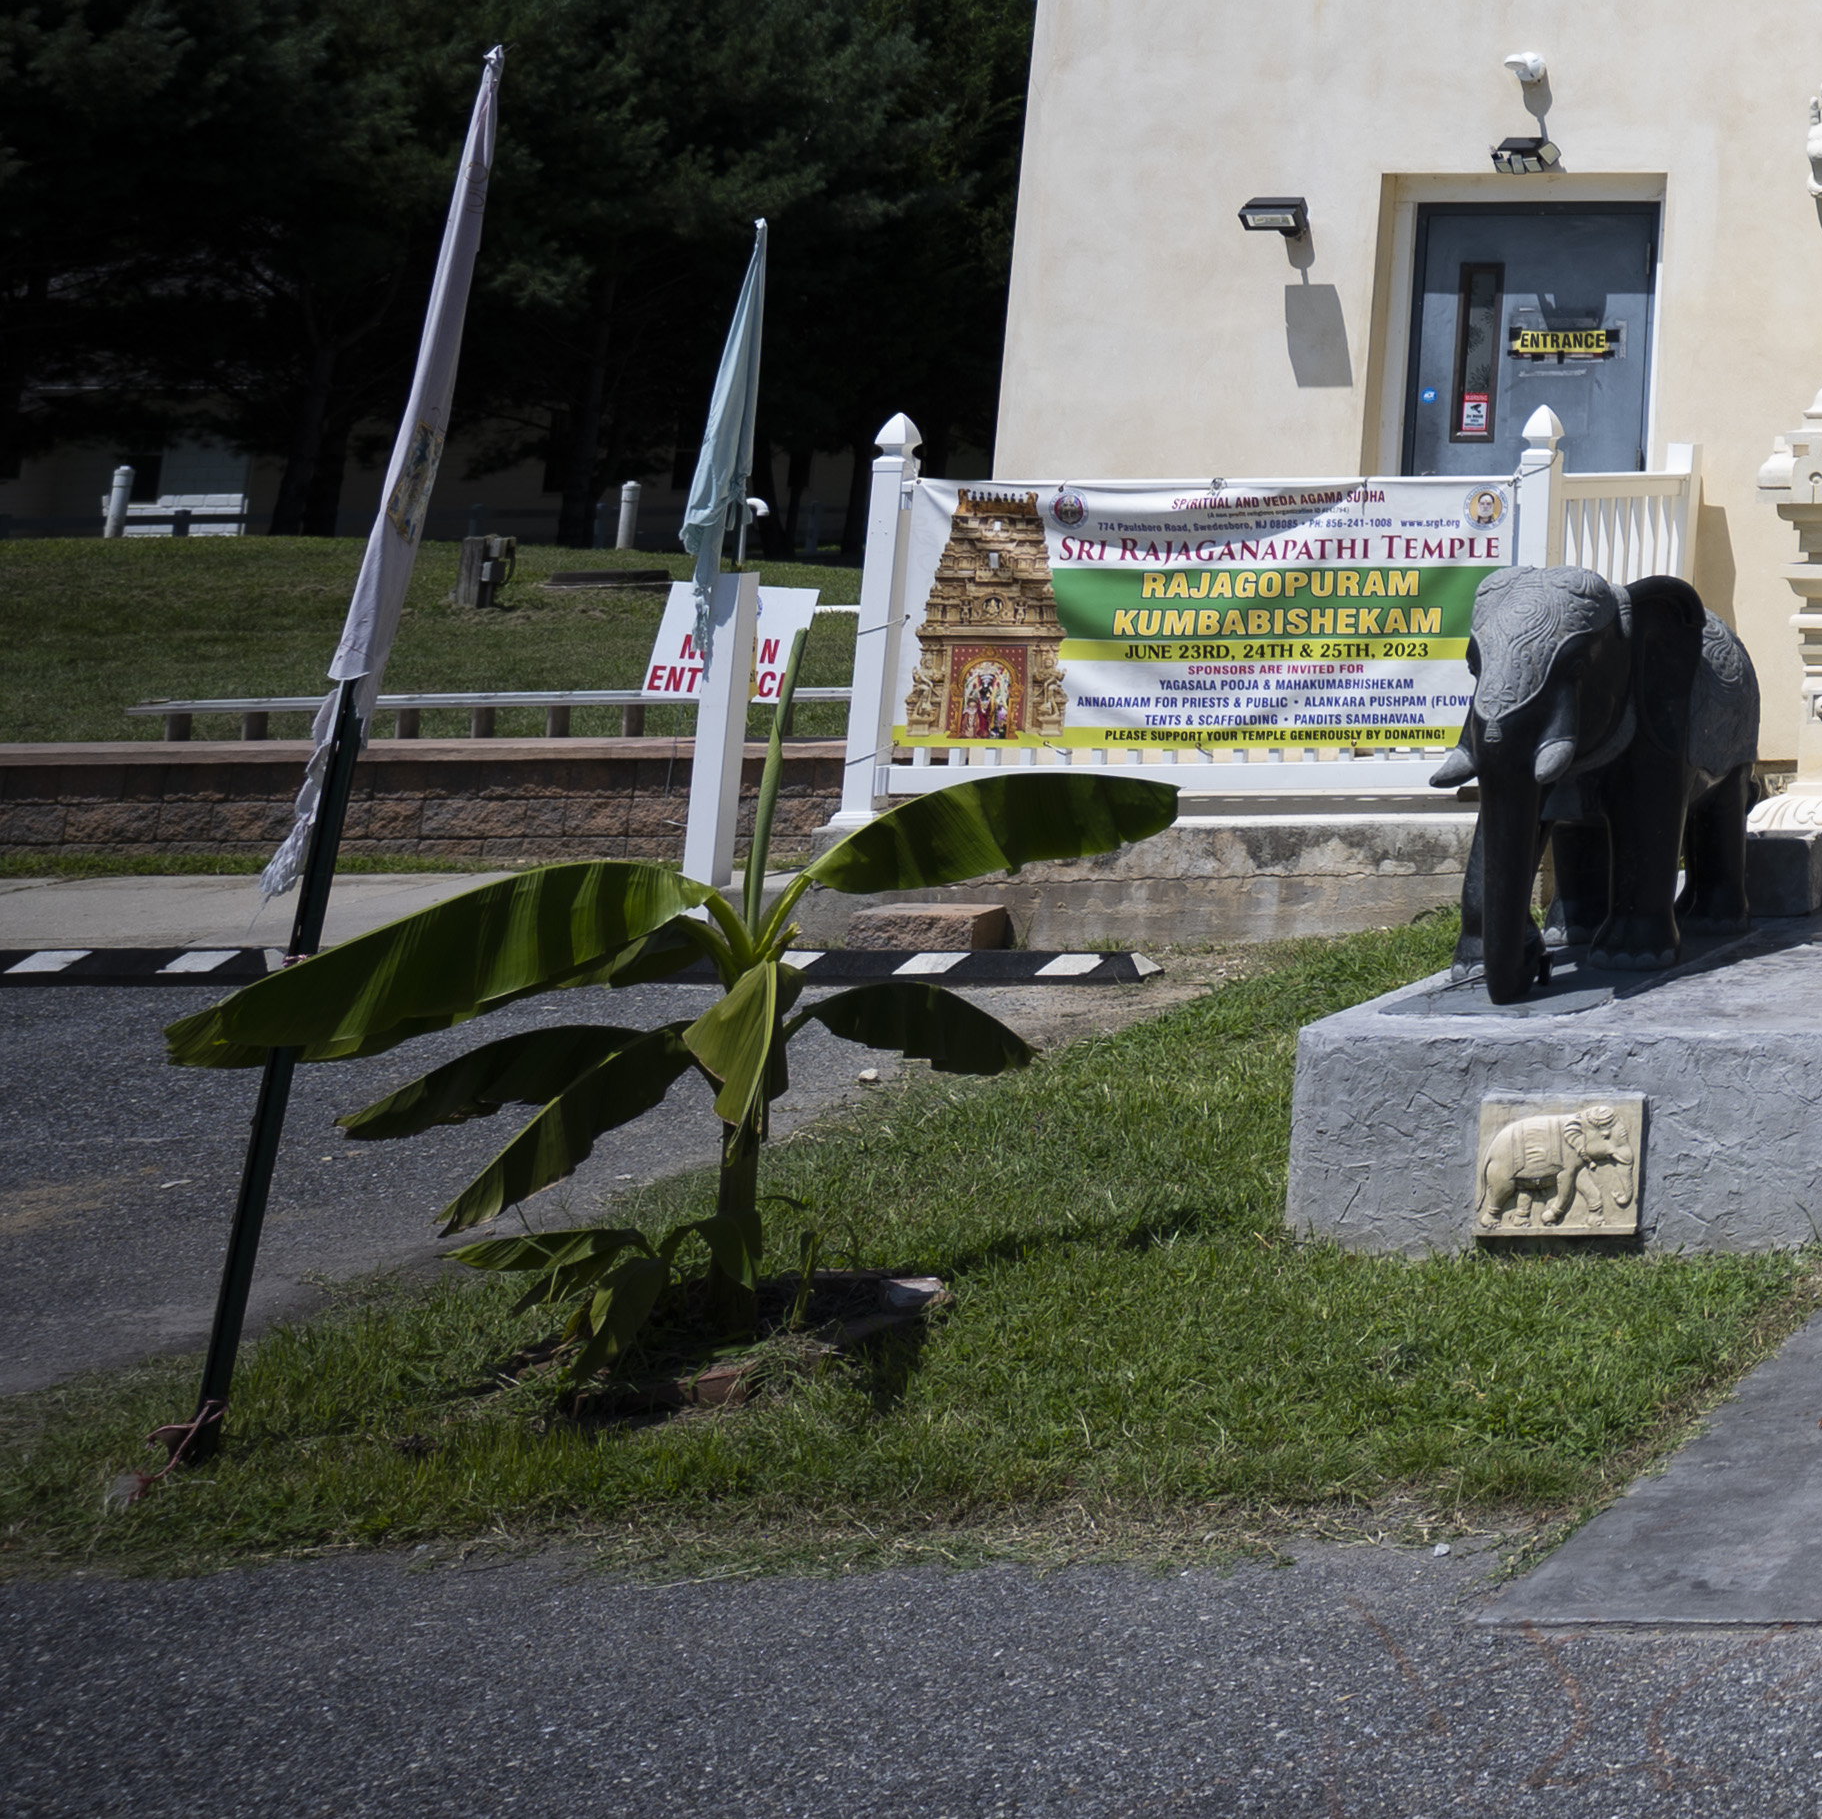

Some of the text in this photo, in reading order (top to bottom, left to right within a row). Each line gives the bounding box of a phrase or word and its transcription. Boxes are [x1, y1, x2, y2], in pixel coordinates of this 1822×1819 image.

[1520, 333, 1605, 349] ENTRANCE
[1172, 497, 1231, 510] SPIRITUAL
[1236, 497, 1259, 508] AND
[1264, 495, 1296, 507] VEDA
[1300, 492, 1342, 504] AGAMA
[1098, 518, 1460, 532] 774 Paulsboro Road, Swedesboro, NJ 08085 PH: 856-241-1008 www.srgt.org
[1060, 534, 1500, 566] SRI RAJAGANAPATHI TEMPLE
[1141, 569, 1420, 599] RAJAGOPURAM
[1112, 607, 1442, 637] KUMBABISHEKAM
[1125, 642, 1428, 661] JUNE 23RD, 24TH & 25TH, 2023
[1188, 664, 1364, 676] SPONSORS ARE INVITED FOR
[1160, 678, 1414, 690] YAGASALA POOJA & MAHAKUMABHISHEKAM
[1077, 696, 1150, 708] ANNADANAM
[1155, 697, 1178, 708] FOR
[1182, 696, 1230, 708] PRIESTS
[1234, 698, 1242, 708] &
[1246, 697, 1288, 708] PUBLIC
[1304, 696, 1366, 708] ALANKARA
[1370, 696, 1426, 707] PUSHPAM
[1145, 714, 1424, 726] TENTS & SCAFFOLDING PANDITS SAMBHAVANA
[1105, 730, 1445, 742] PLEASE SUPPORT YOUR TEMPLE GENEROUSLY BY DONATING!
